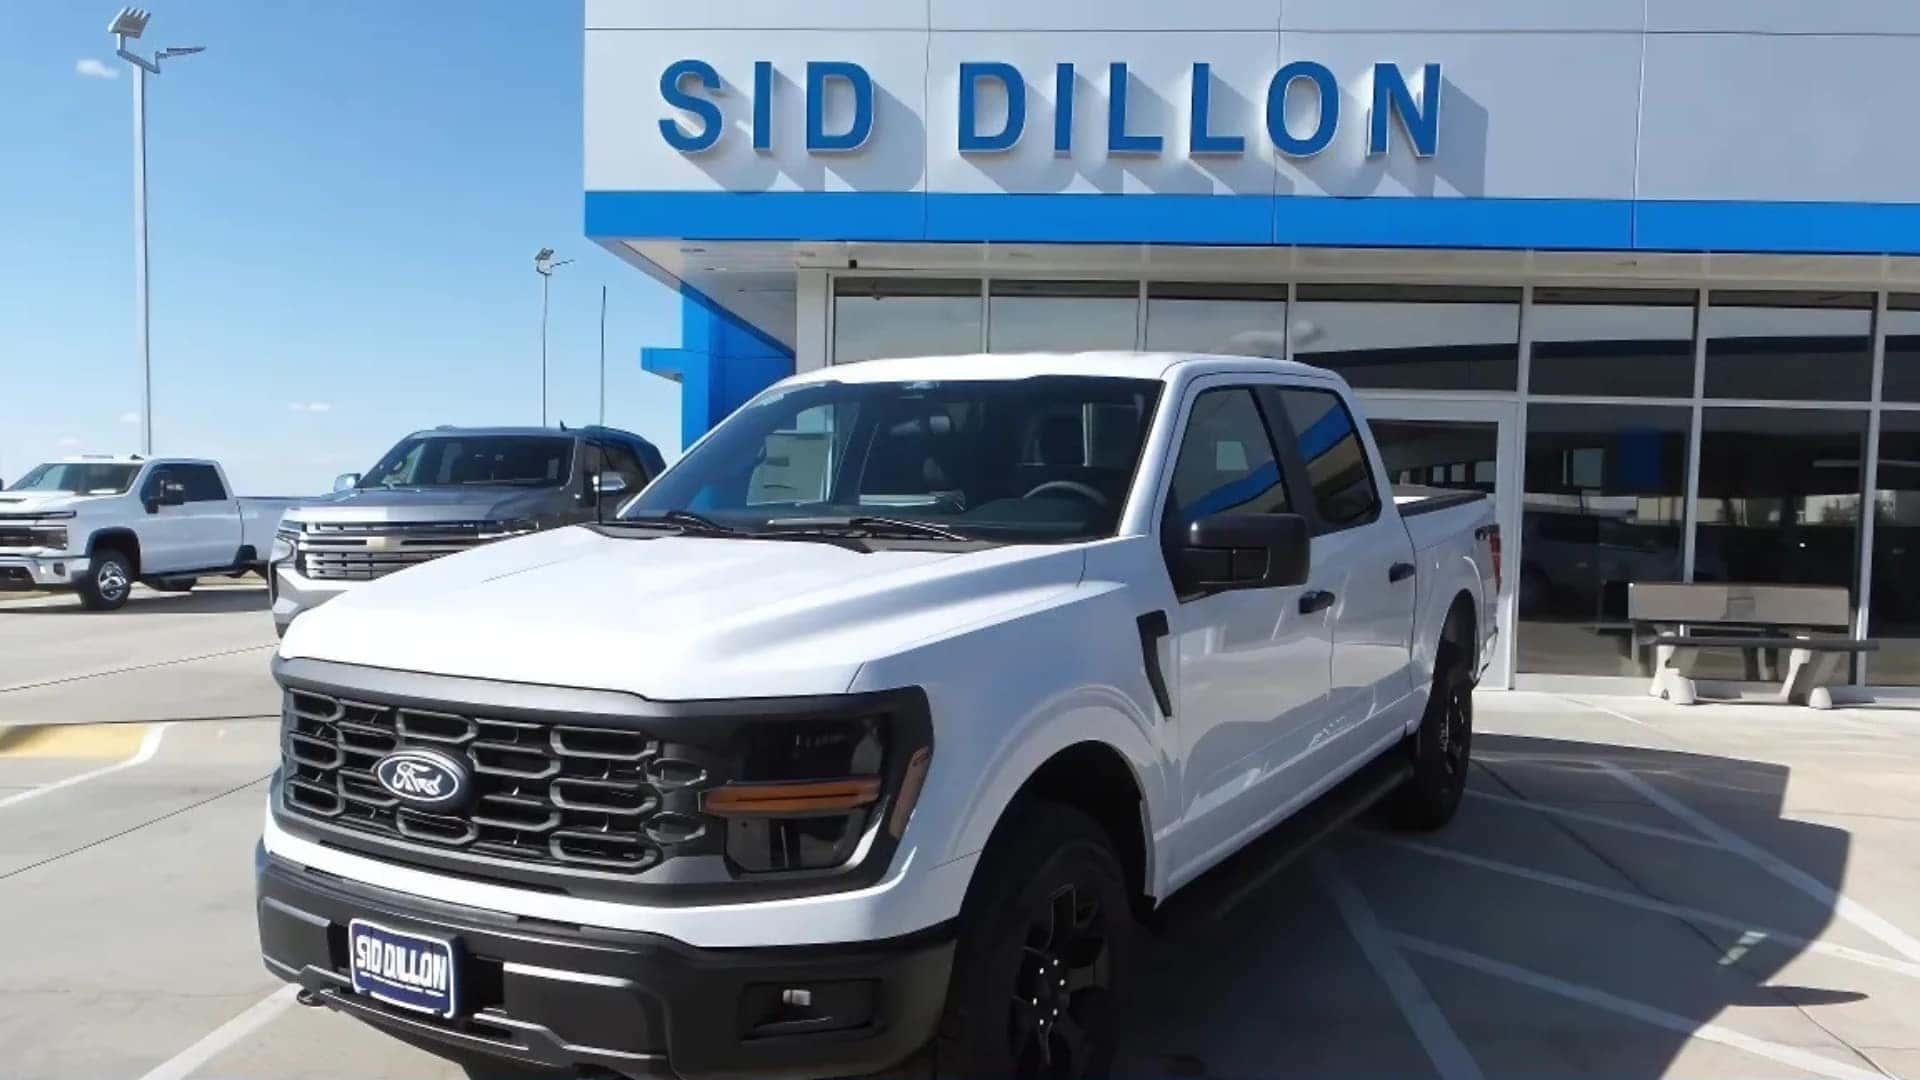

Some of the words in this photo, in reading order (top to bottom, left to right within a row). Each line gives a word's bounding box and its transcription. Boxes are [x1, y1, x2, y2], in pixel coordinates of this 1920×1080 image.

[658, 58, 874, 153] SID
[958, 60, 1441, 158] DILLON
[392, 761, 442, 796] Ford
